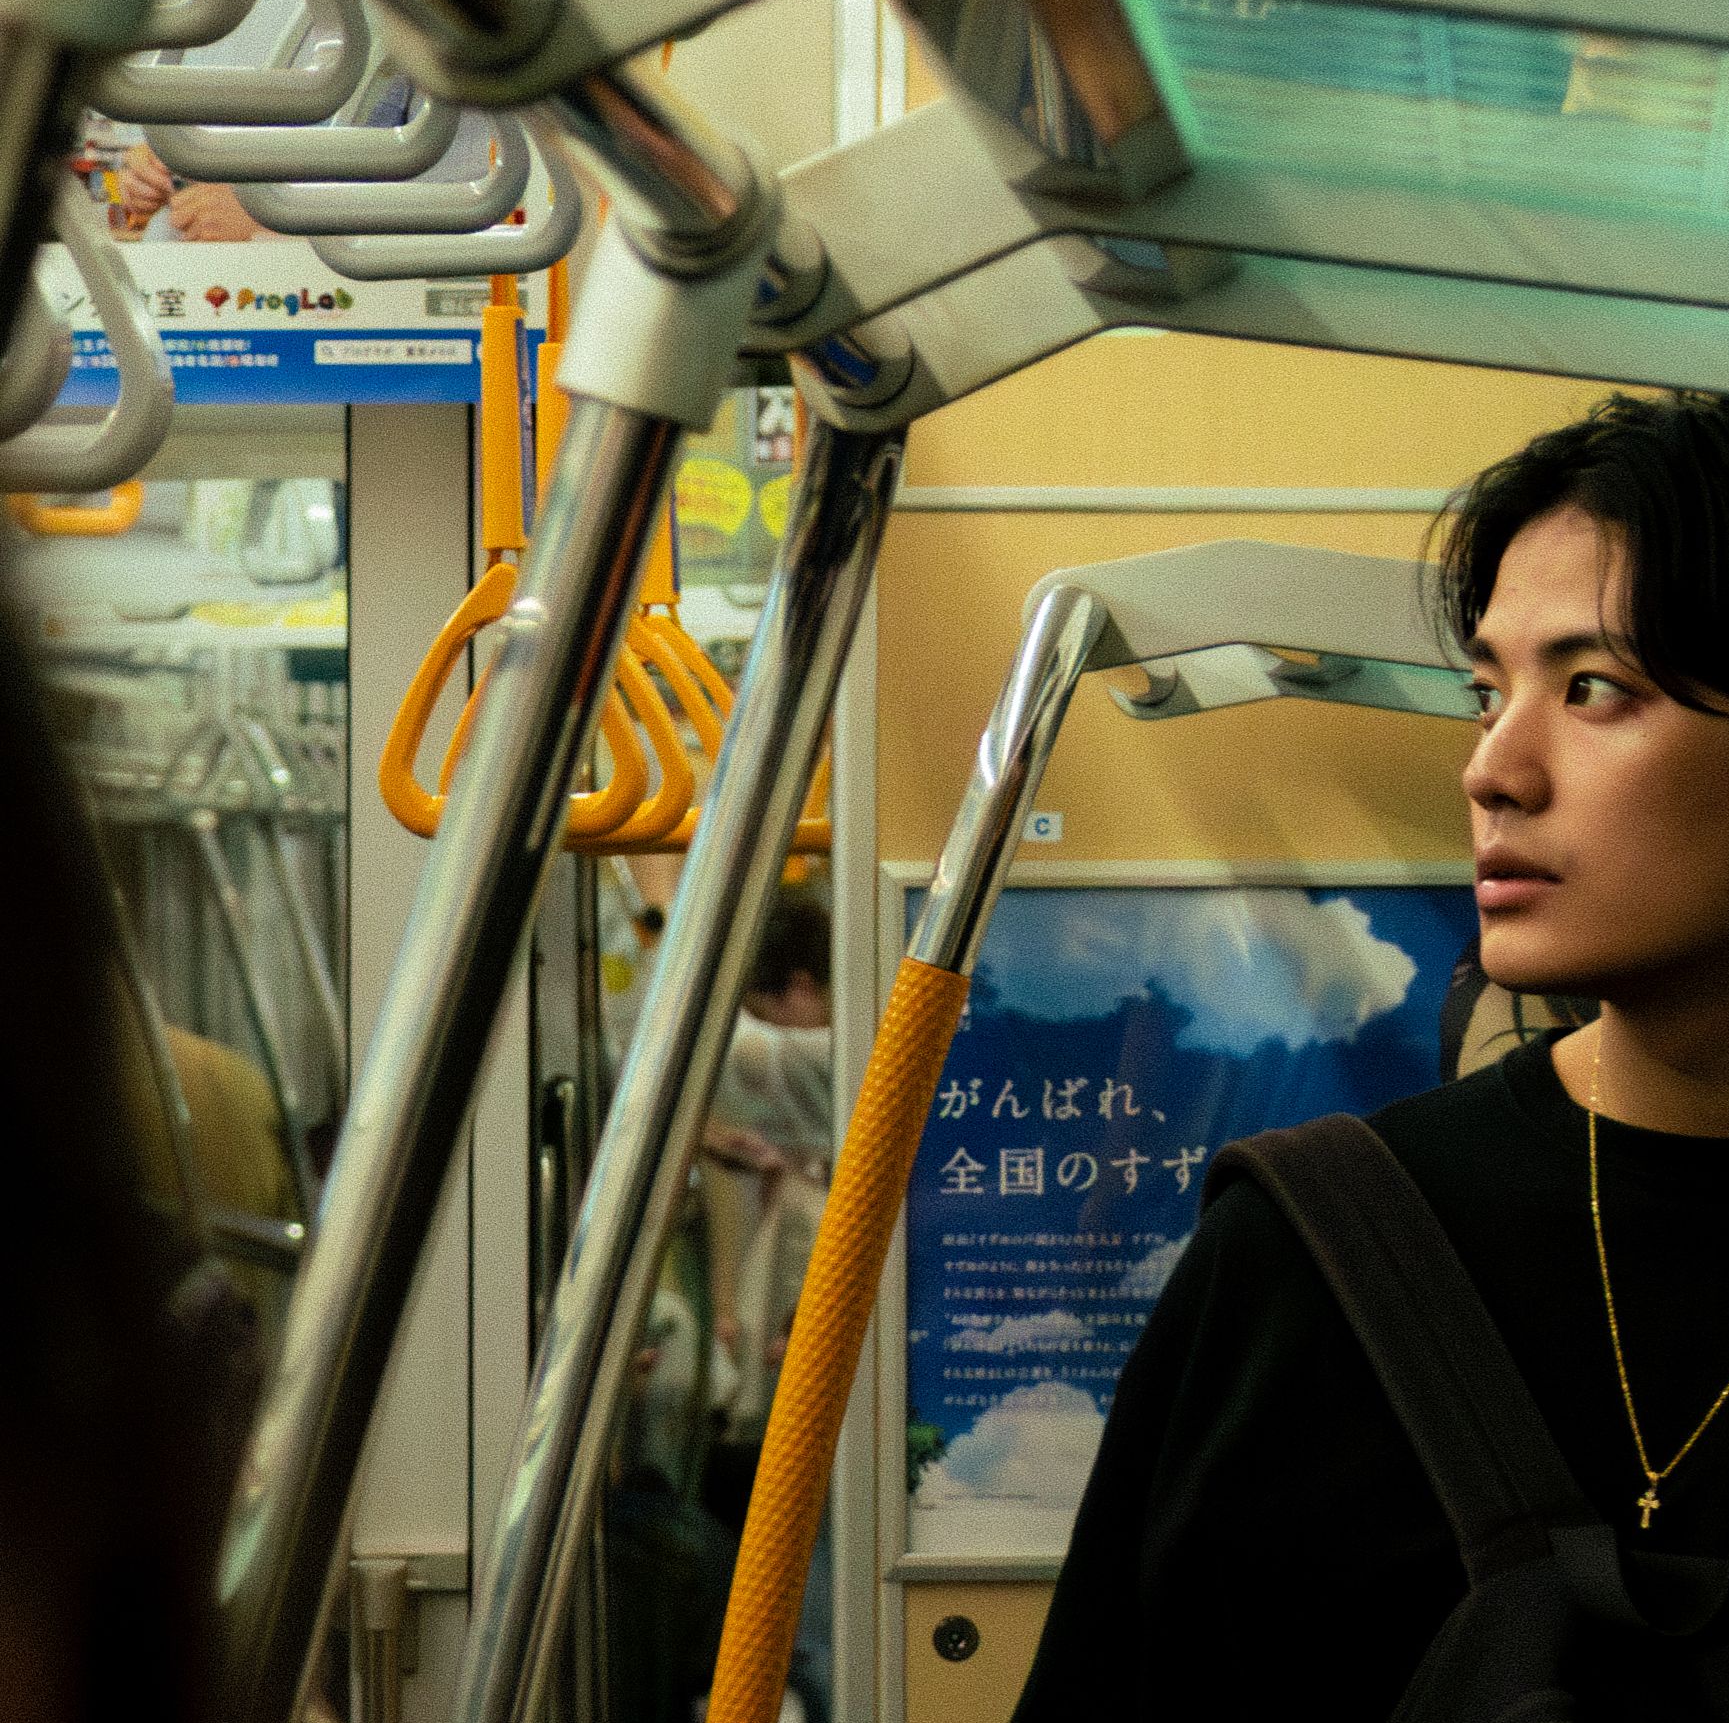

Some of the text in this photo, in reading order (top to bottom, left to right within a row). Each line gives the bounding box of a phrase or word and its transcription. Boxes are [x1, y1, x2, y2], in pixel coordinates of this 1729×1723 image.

[236, 286, 354, 317] ProgLab
[1034, 816, 1050, 836] C
[938, 1077, 1167, 1122] がんばれ、
[938, 1144, 1208, 1197] 全国のすず
